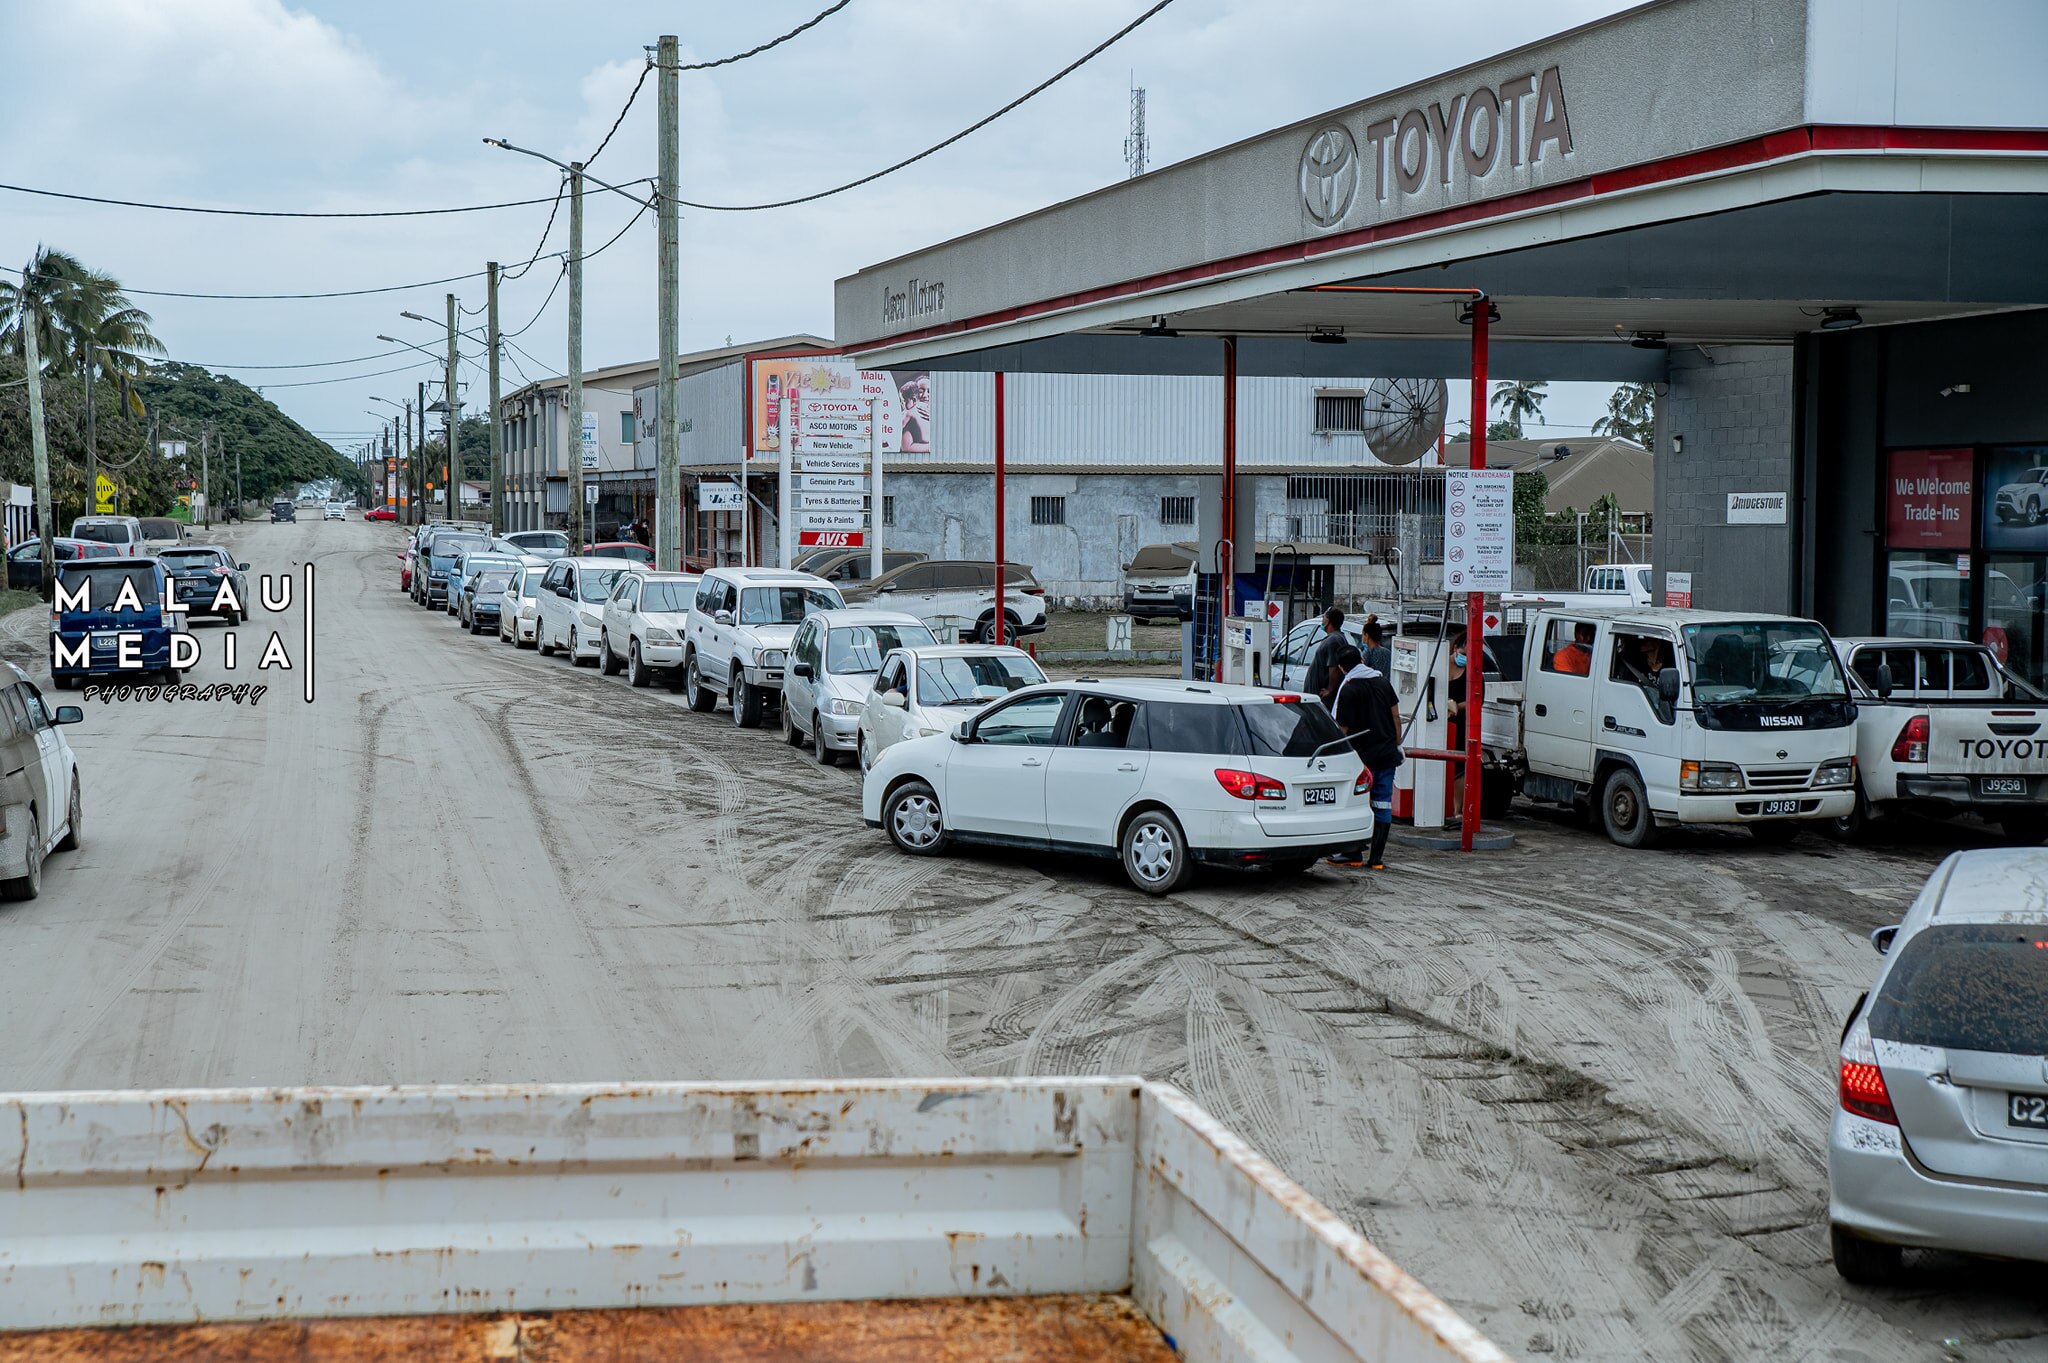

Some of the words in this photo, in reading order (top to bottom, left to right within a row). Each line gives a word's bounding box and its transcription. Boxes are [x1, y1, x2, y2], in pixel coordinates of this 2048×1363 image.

[1367, 66, 1574, 201] TOYOTA
[883, 286, 906, 323] Asco
[909, 278, 945, 317] Motors
[861, 371, 886, 381] Malu,
[863, 385, 884, 395] Hao,
[809, 422, 828, 430] ASCO
[829, 423, 858, 431] MOTORS
[813, 441, 828, 449] New
[829, 442, 854, 450] Vehicle
[831, 460, 860, 468] Services
[810, 478, 837, 486] Genuine
[838, 478, 855, 486] Parts
[1896, 479, 1914, 495] We
[1917, 478, 1971, 495] Welcome
[805, 497, 823, 506] Tyres
[1731, 496, 1784, 509] BRIDGESTONE
[1904, 503, 1960, 521] Trade-Ins
[809, 516, 826, 525] Body
[827, 516, 833, 524] &
[834, 516, 855, 524] Paints
[815, 532, 849, 547] AVIS
[1760, 715, 1803, 727] NISSAN
[1959, 739, 2048, 759] TOYOT
[1305, 788, 1335, 802] C27450
[1766, 800, 1796, 813] J9183
[2012, 1096, 2048, 1123] C2
